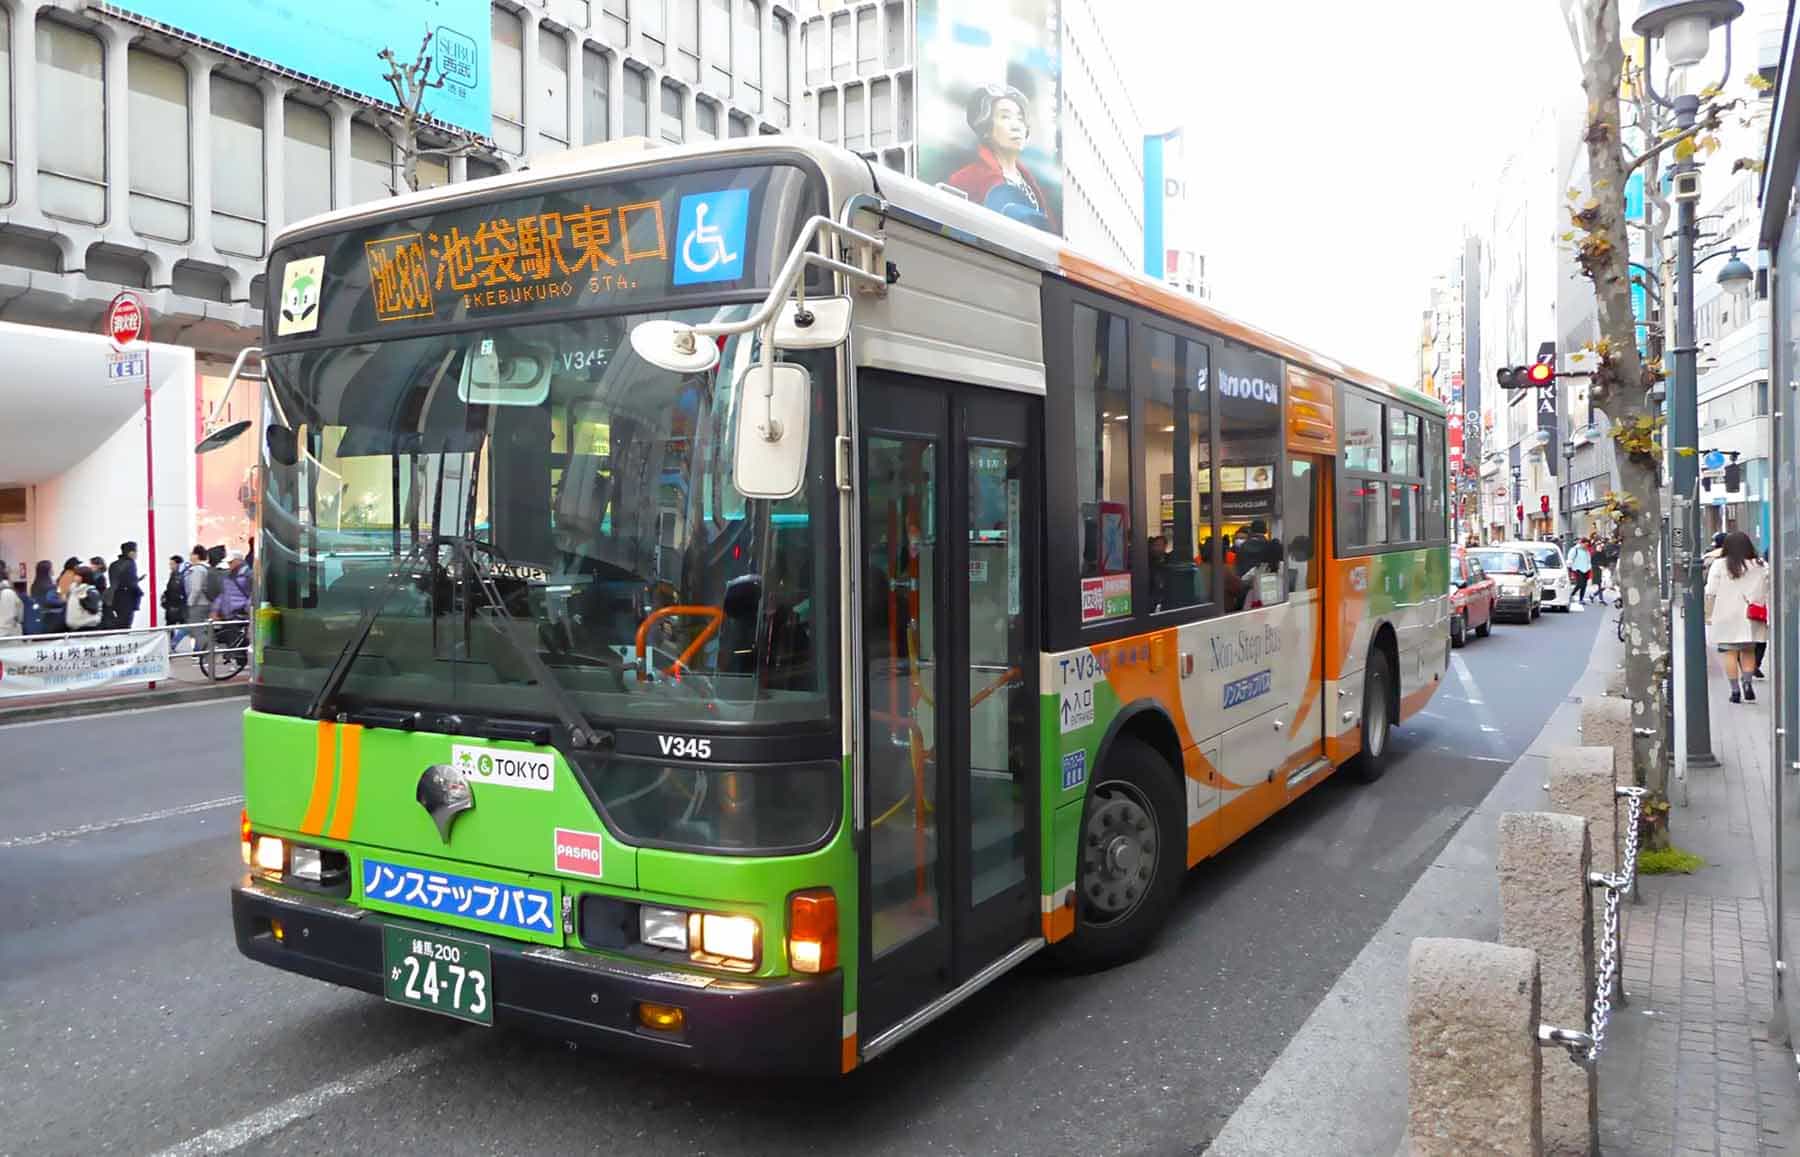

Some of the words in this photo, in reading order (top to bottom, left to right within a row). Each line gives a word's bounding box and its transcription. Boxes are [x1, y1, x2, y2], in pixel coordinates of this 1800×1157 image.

[428, 200, 668, 291] 池袋駅東口
[463, 280, 573, 309] IKEBUKURO
[1538, 354, 1556, 414] ZRA
[1073, 688, 1093, 713] 入口
[658, 735, 712, 759] V345
[495, 757, 550, 781] TOKYO
[557, 844, 599, 862] PASMO
[365, 864, 553, 929] ノンステップバス
[403, 955, 487, 1014] 24-73
